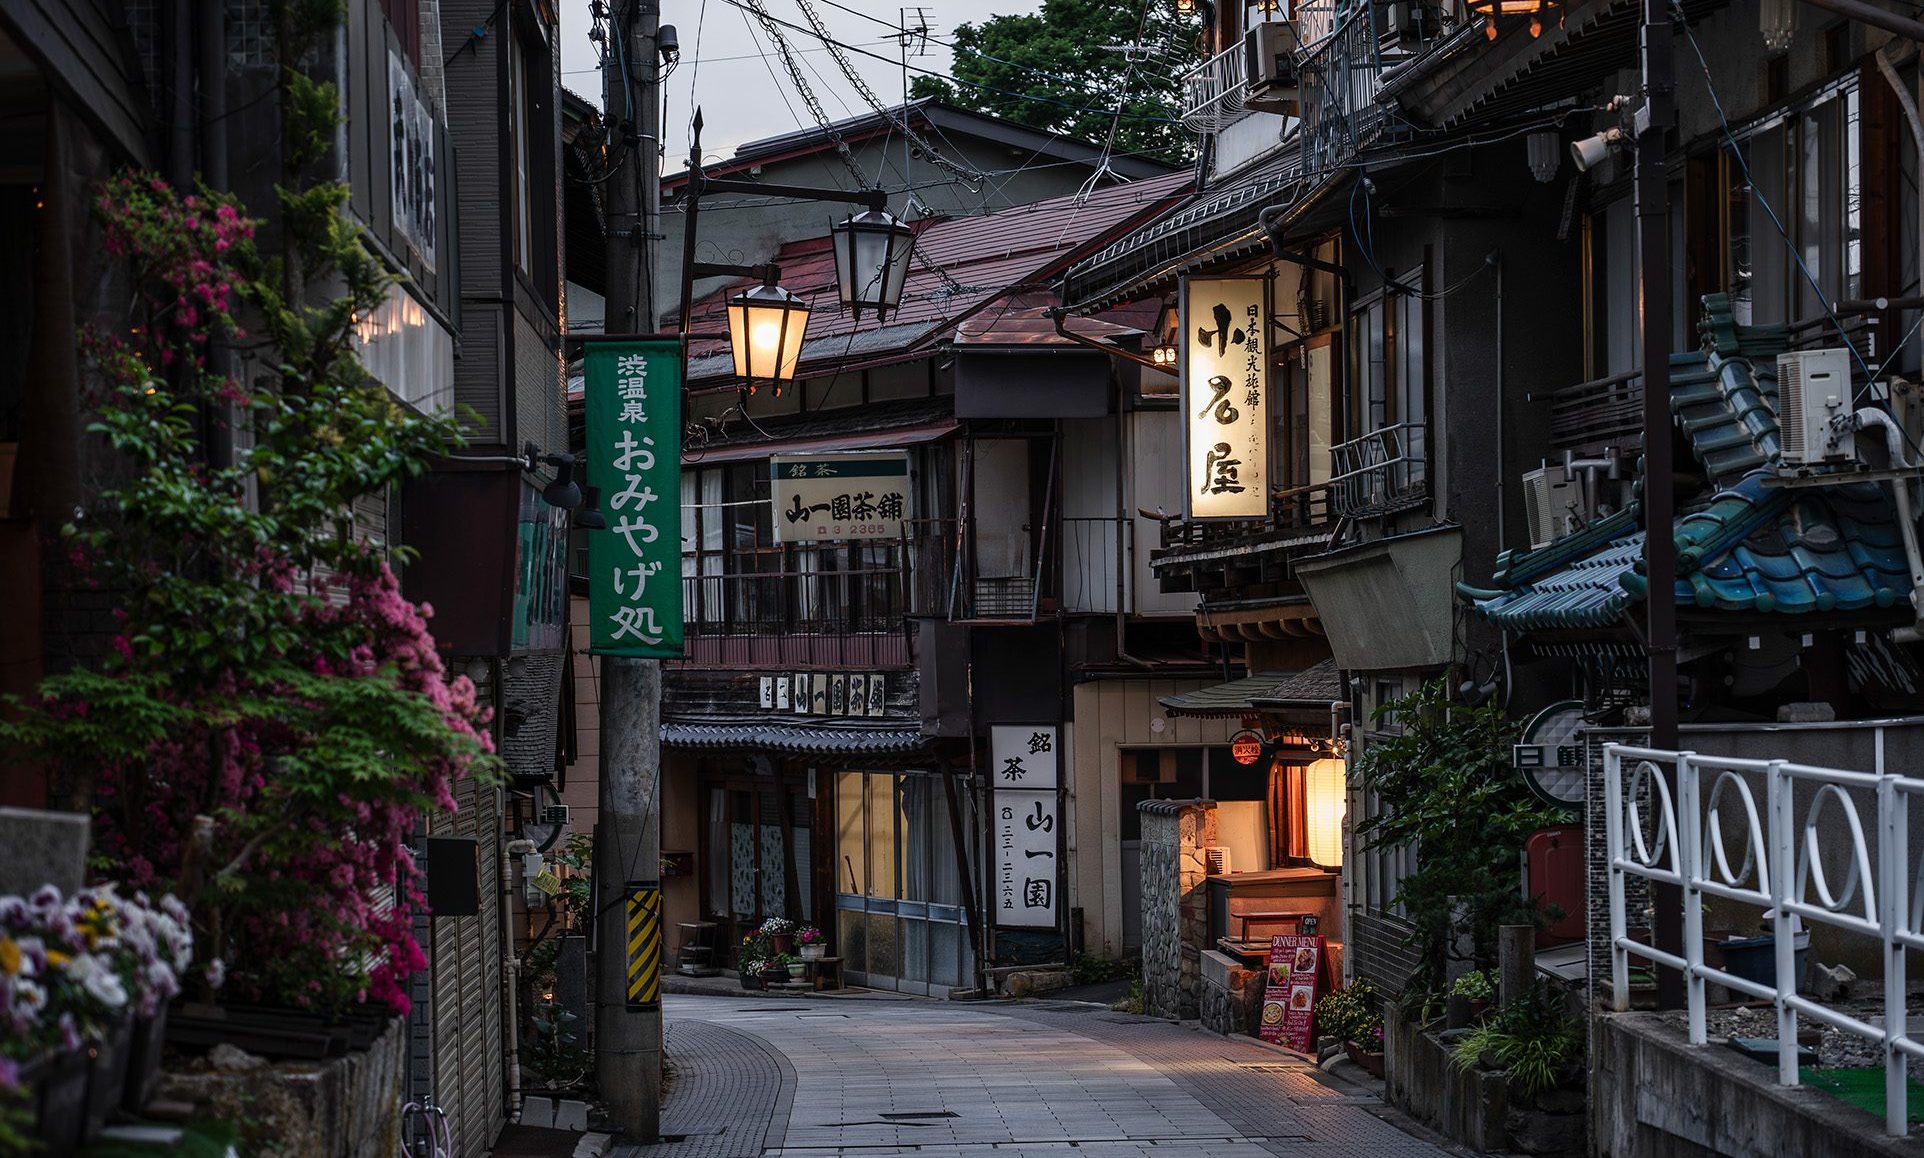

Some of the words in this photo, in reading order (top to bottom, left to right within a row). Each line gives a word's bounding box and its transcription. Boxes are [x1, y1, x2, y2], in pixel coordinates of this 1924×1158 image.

[617, 354, 648, 424] 渋温泉
[788, 463, 839, 478] 銘茶
[785, 491, 903, 523] 山一園茶舗
[609, 430, 664, 646] おみやげ処
[1001, 732, 1053, 781] 銘茶
[1234, 744, 1259, 756] 消火栓
[1024, 801, 1054, 909] 山一園
[1304, 917, 1317, 925] OPEN
[1272, 935, 1297, 947] DINNER
[1298, 936, 1318, 948] MENU
